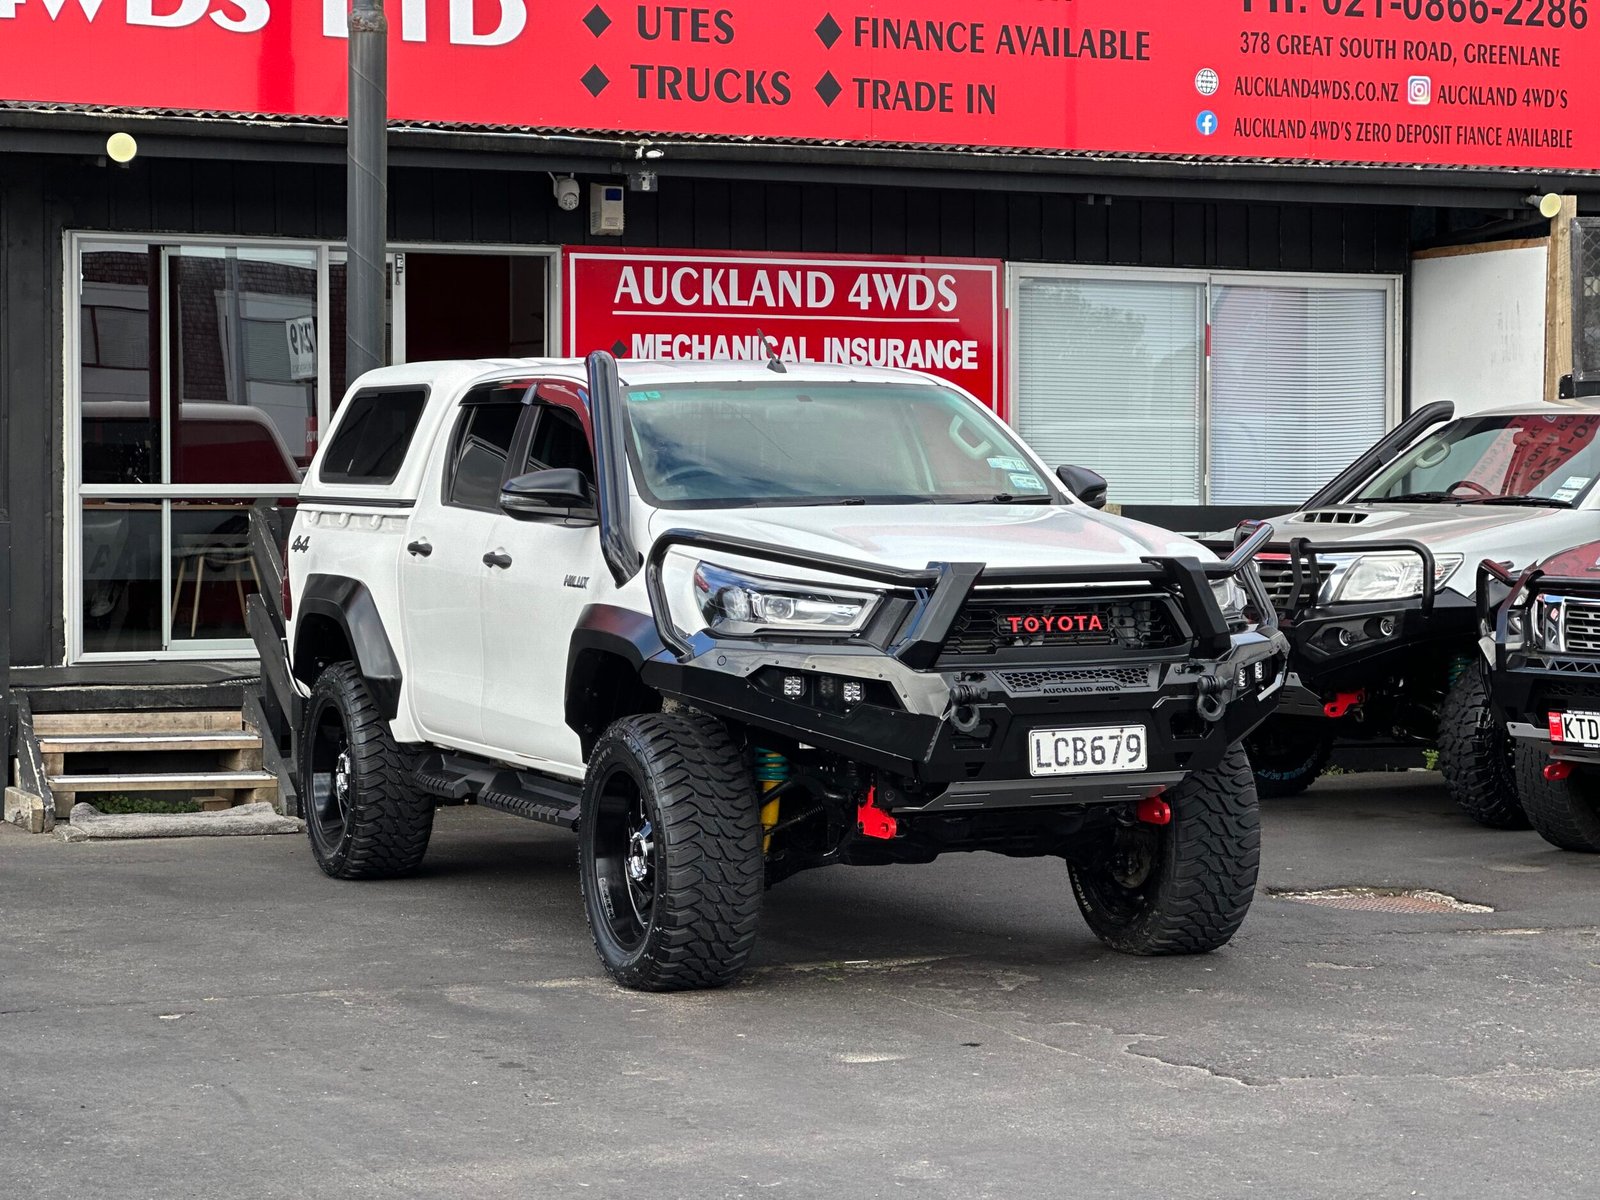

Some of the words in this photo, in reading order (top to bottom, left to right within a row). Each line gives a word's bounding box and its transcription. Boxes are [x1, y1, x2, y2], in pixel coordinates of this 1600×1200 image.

[637, 5, 735, 45] UTES
[854, 16, 985, 54] FINANCE
[995, 24, 1151, 61] AVAILABLE
[1240, 31, 1270, 55] 378
[1276, 34, 1334, 57] GREAT
[1339, 37, 1397, 60] SOUTH
[1403, 40, 1458, 67] ROAD,
[1463, 43, 1561, 68] GREENLANE
[630, 64, 792, 106] TRUCKS
[852, 77, 954, 113] TRADE
[966, 84, 997, 115] IN
[1234, 76, 1399, 103] AUCKLAND4WDS.CO.NZ
[1437, 84, 1518, 107] AUCKLAND
[1521, 88, 1569, 109] 4WD'S
[1234, 117, 1307, 140] AUCKLAND
[1309, 120, 1352, 142] 4WD'S
[1355, 122, 1392, 143] ZERO
[1396, 123, 1452, 145] DEPOSIT
[1456, 125, 1503, 146] FIANCE
[1507, 127, 1574, 149] AVAILABLE
[613, 266, 835, 308] AUCKLAND
[848, 273, 958, 312] 4WDS
[631, 333, 815, 363] MECHANICAL
[823, 337, 978, 369] INSURANCE
[563, 574, 590, 589] HILUX
[1007, 614, 1104, 633] TOYOTA
[1043, 686, 1093, 694] AUCKLAND
[1563, 717, 1599, 740] KTD
[1035, 734, 1141, 768] LCB679
